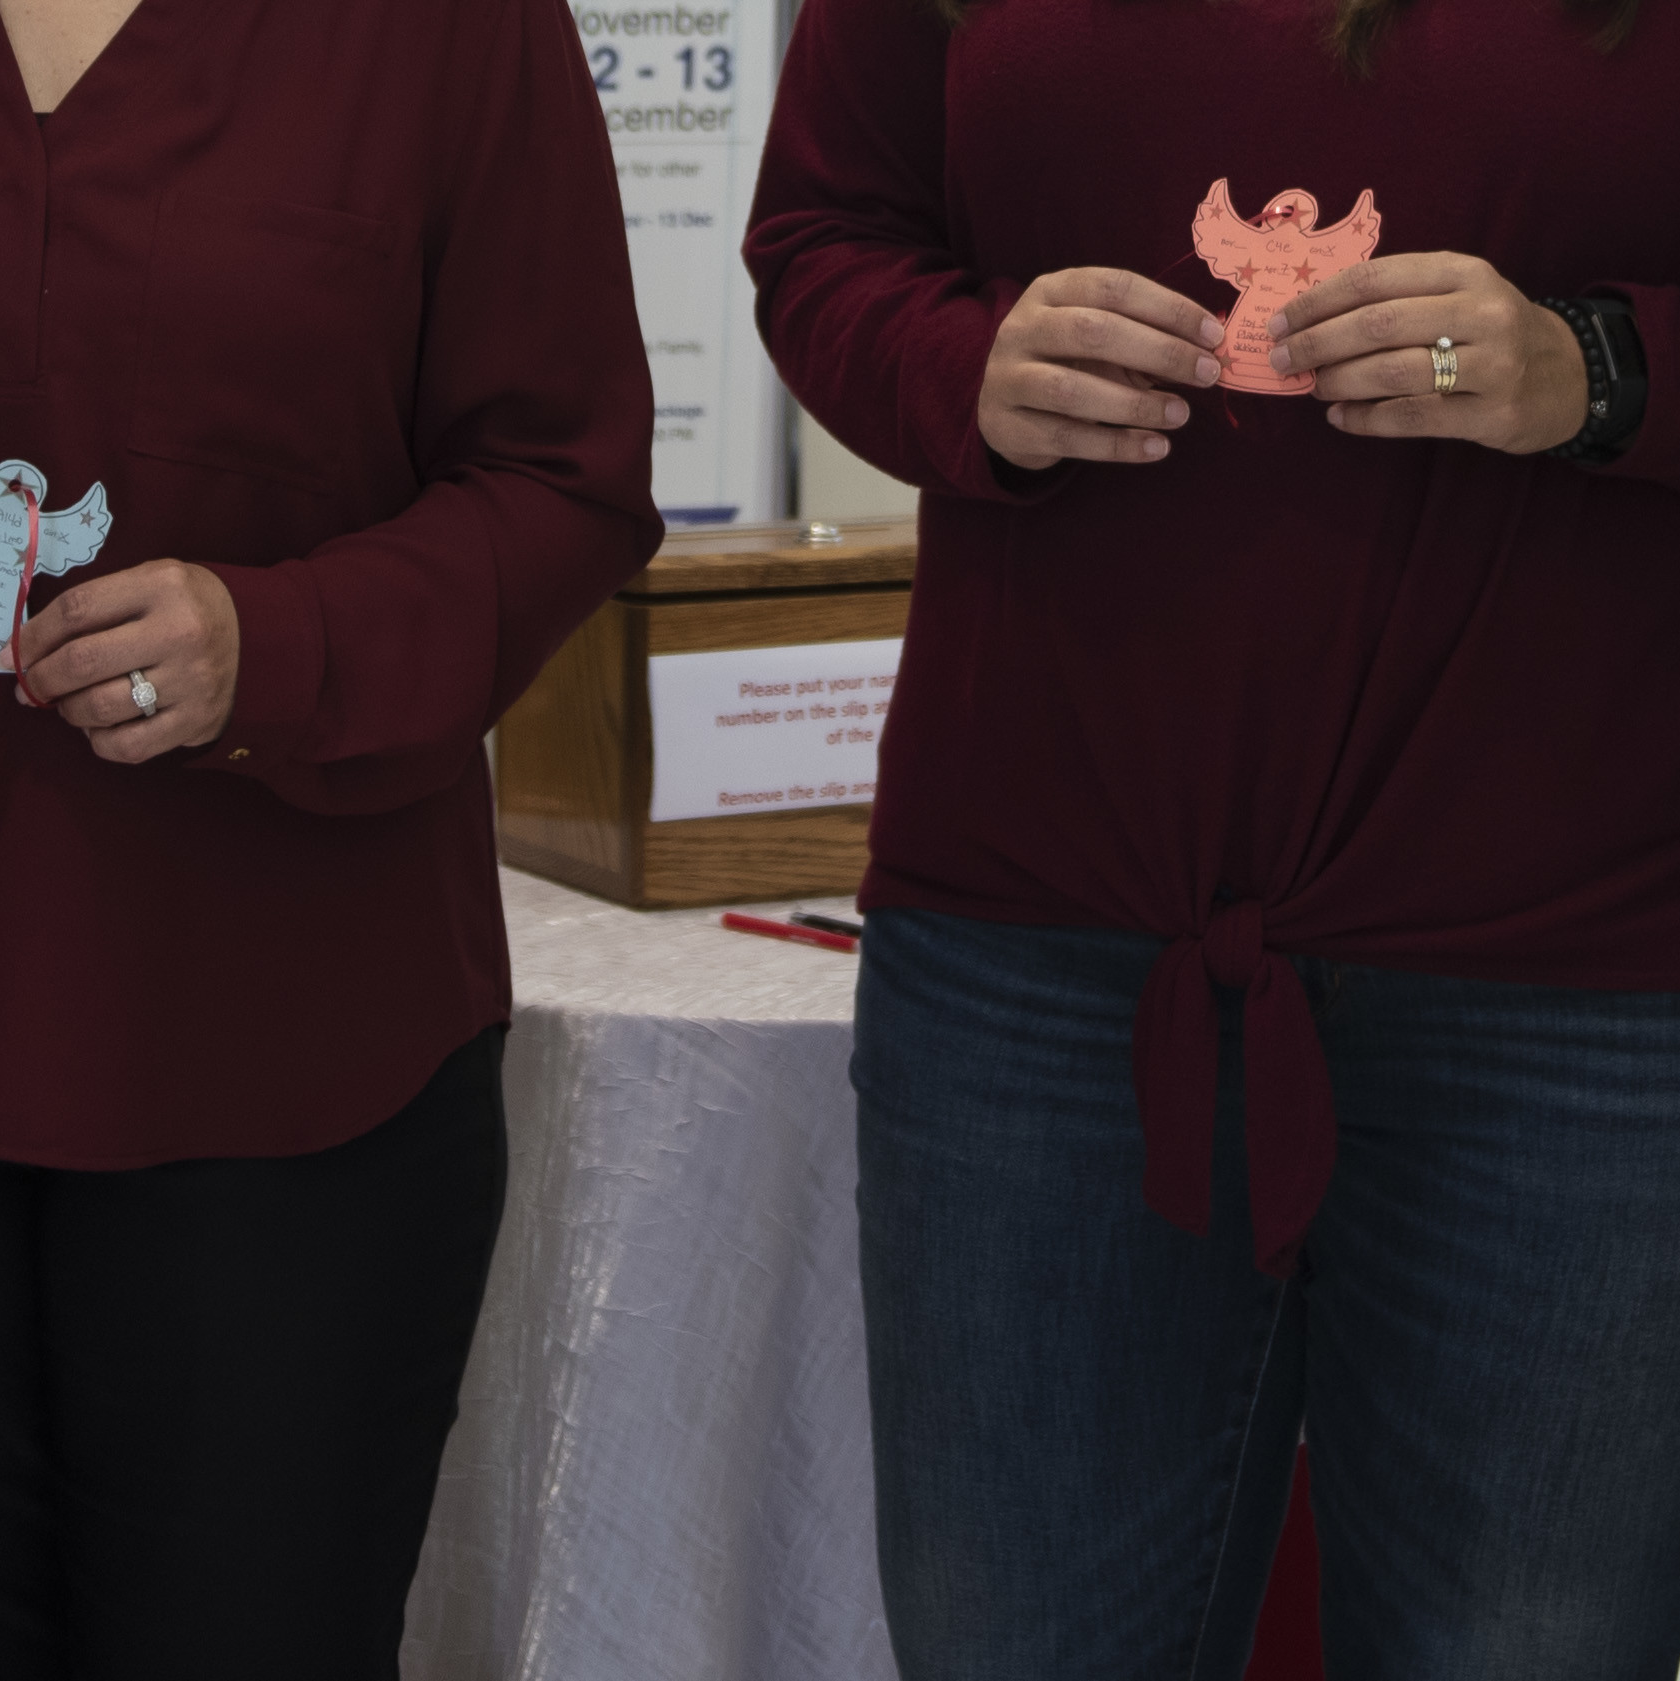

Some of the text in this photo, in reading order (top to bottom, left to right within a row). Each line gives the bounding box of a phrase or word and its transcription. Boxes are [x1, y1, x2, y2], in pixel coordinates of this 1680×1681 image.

[591, 44, 619, 92] 2
[676, 44, 733, 92] 13
[605, 101, 733, 132] cember
[739, 681, 791, 698] Please
[796, 679, 824, 697] put
[828, 677, 864, 695] your
[716, 708, 779, 727] number
[785, 708, 804, 722] on
[810, 703, 836, 720] the
[842, 700, 868, 719] slip
[826, 727, 874, 746] of the
[719, 789, 783, 807] Remove
[788, 785, 815, 801] the
[820, 782, 846, 800] slip
